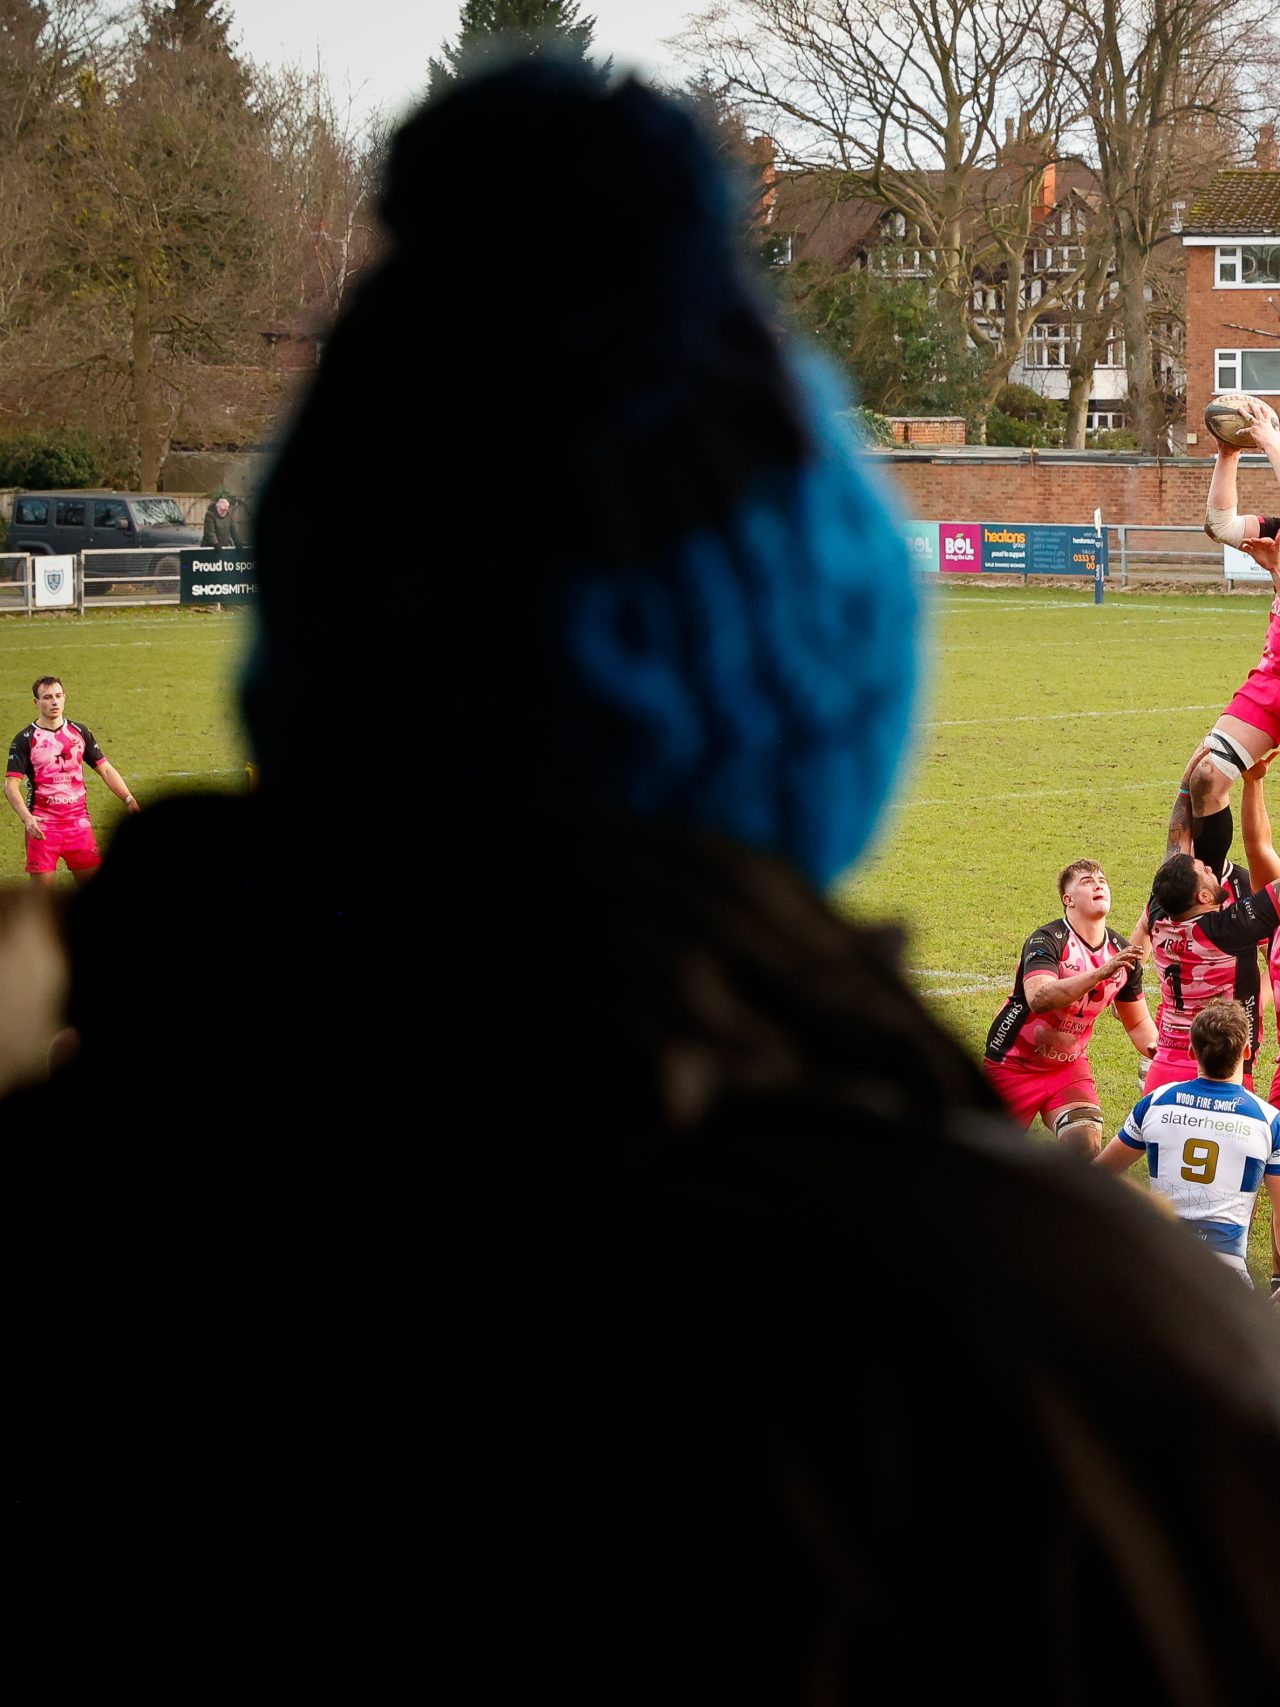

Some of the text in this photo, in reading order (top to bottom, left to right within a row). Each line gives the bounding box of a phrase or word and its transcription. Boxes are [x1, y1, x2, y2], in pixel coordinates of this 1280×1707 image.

[945, 537, 974, 554] BOL
[984, 529, 1025, 543] heatons
[192, 560, 222, 572] Proud
[223, 561, 234, 572] to
[989, 1001, 1024, 1051] THATCHERS
[1176, 1091, 1237, 1112] WOOD FIRE SMOKE
[1161, 1110, 1251, 1136] slaterheelis
[1180, 1138, 1220, 1185] 9
